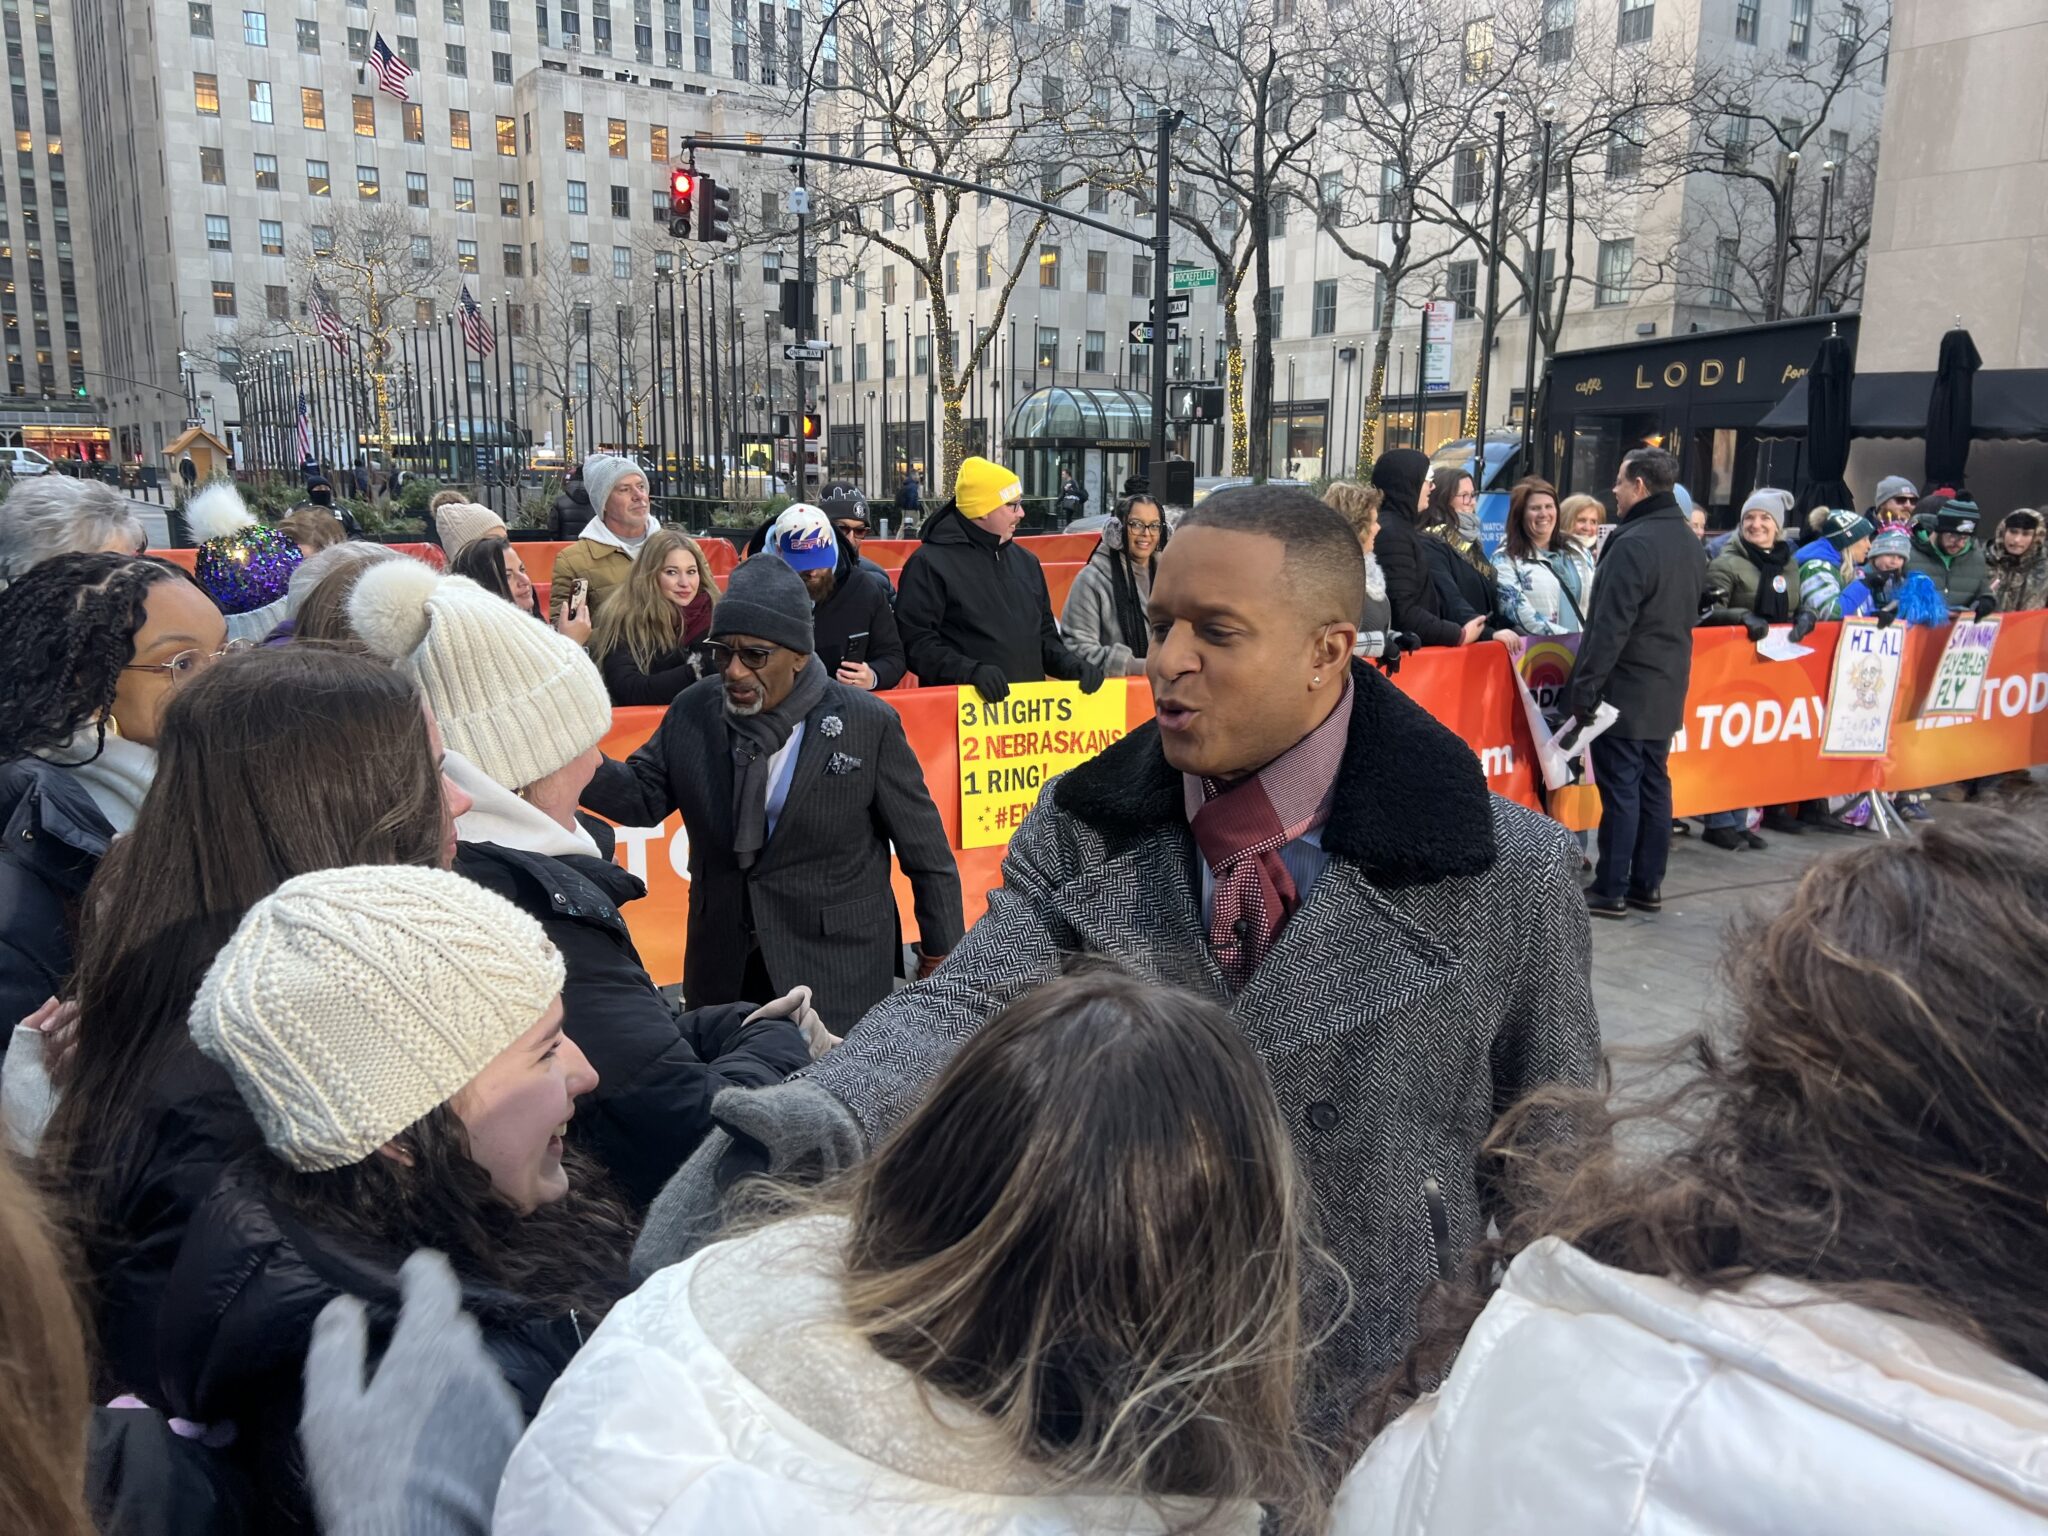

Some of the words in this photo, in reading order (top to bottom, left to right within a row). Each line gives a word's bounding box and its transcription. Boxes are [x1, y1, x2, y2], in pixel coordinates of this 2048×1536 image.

[1175, 270, 1215, 281] ROCKEFELLER
[1171, 302, 1184, 312] WAY
[1136, 327, 1151, 336] ONE
[1635, 356, 1745, 389] LODI
[1480, 532, 1496, 541] OUR
[1482, 522, 1504, 532] WATCH
[1851, 629, 1874, 653] HI
[1879, 631, 1900, 656] AL
[1934, 678, 1966, 709] FLY
[1983, 672, 2048, 720] TOD
[961, 702, 978, 727] 3
[983, 697, 1072, 727] NIGHTS
[963, 736, 980, 761] 2
[986, 729, 1123, 760] NEBRASKANS
[964, 771, 982, 795] 1
[987, 763, 1048, 794] RING!
[995, 802, 1034, 830] #EN
